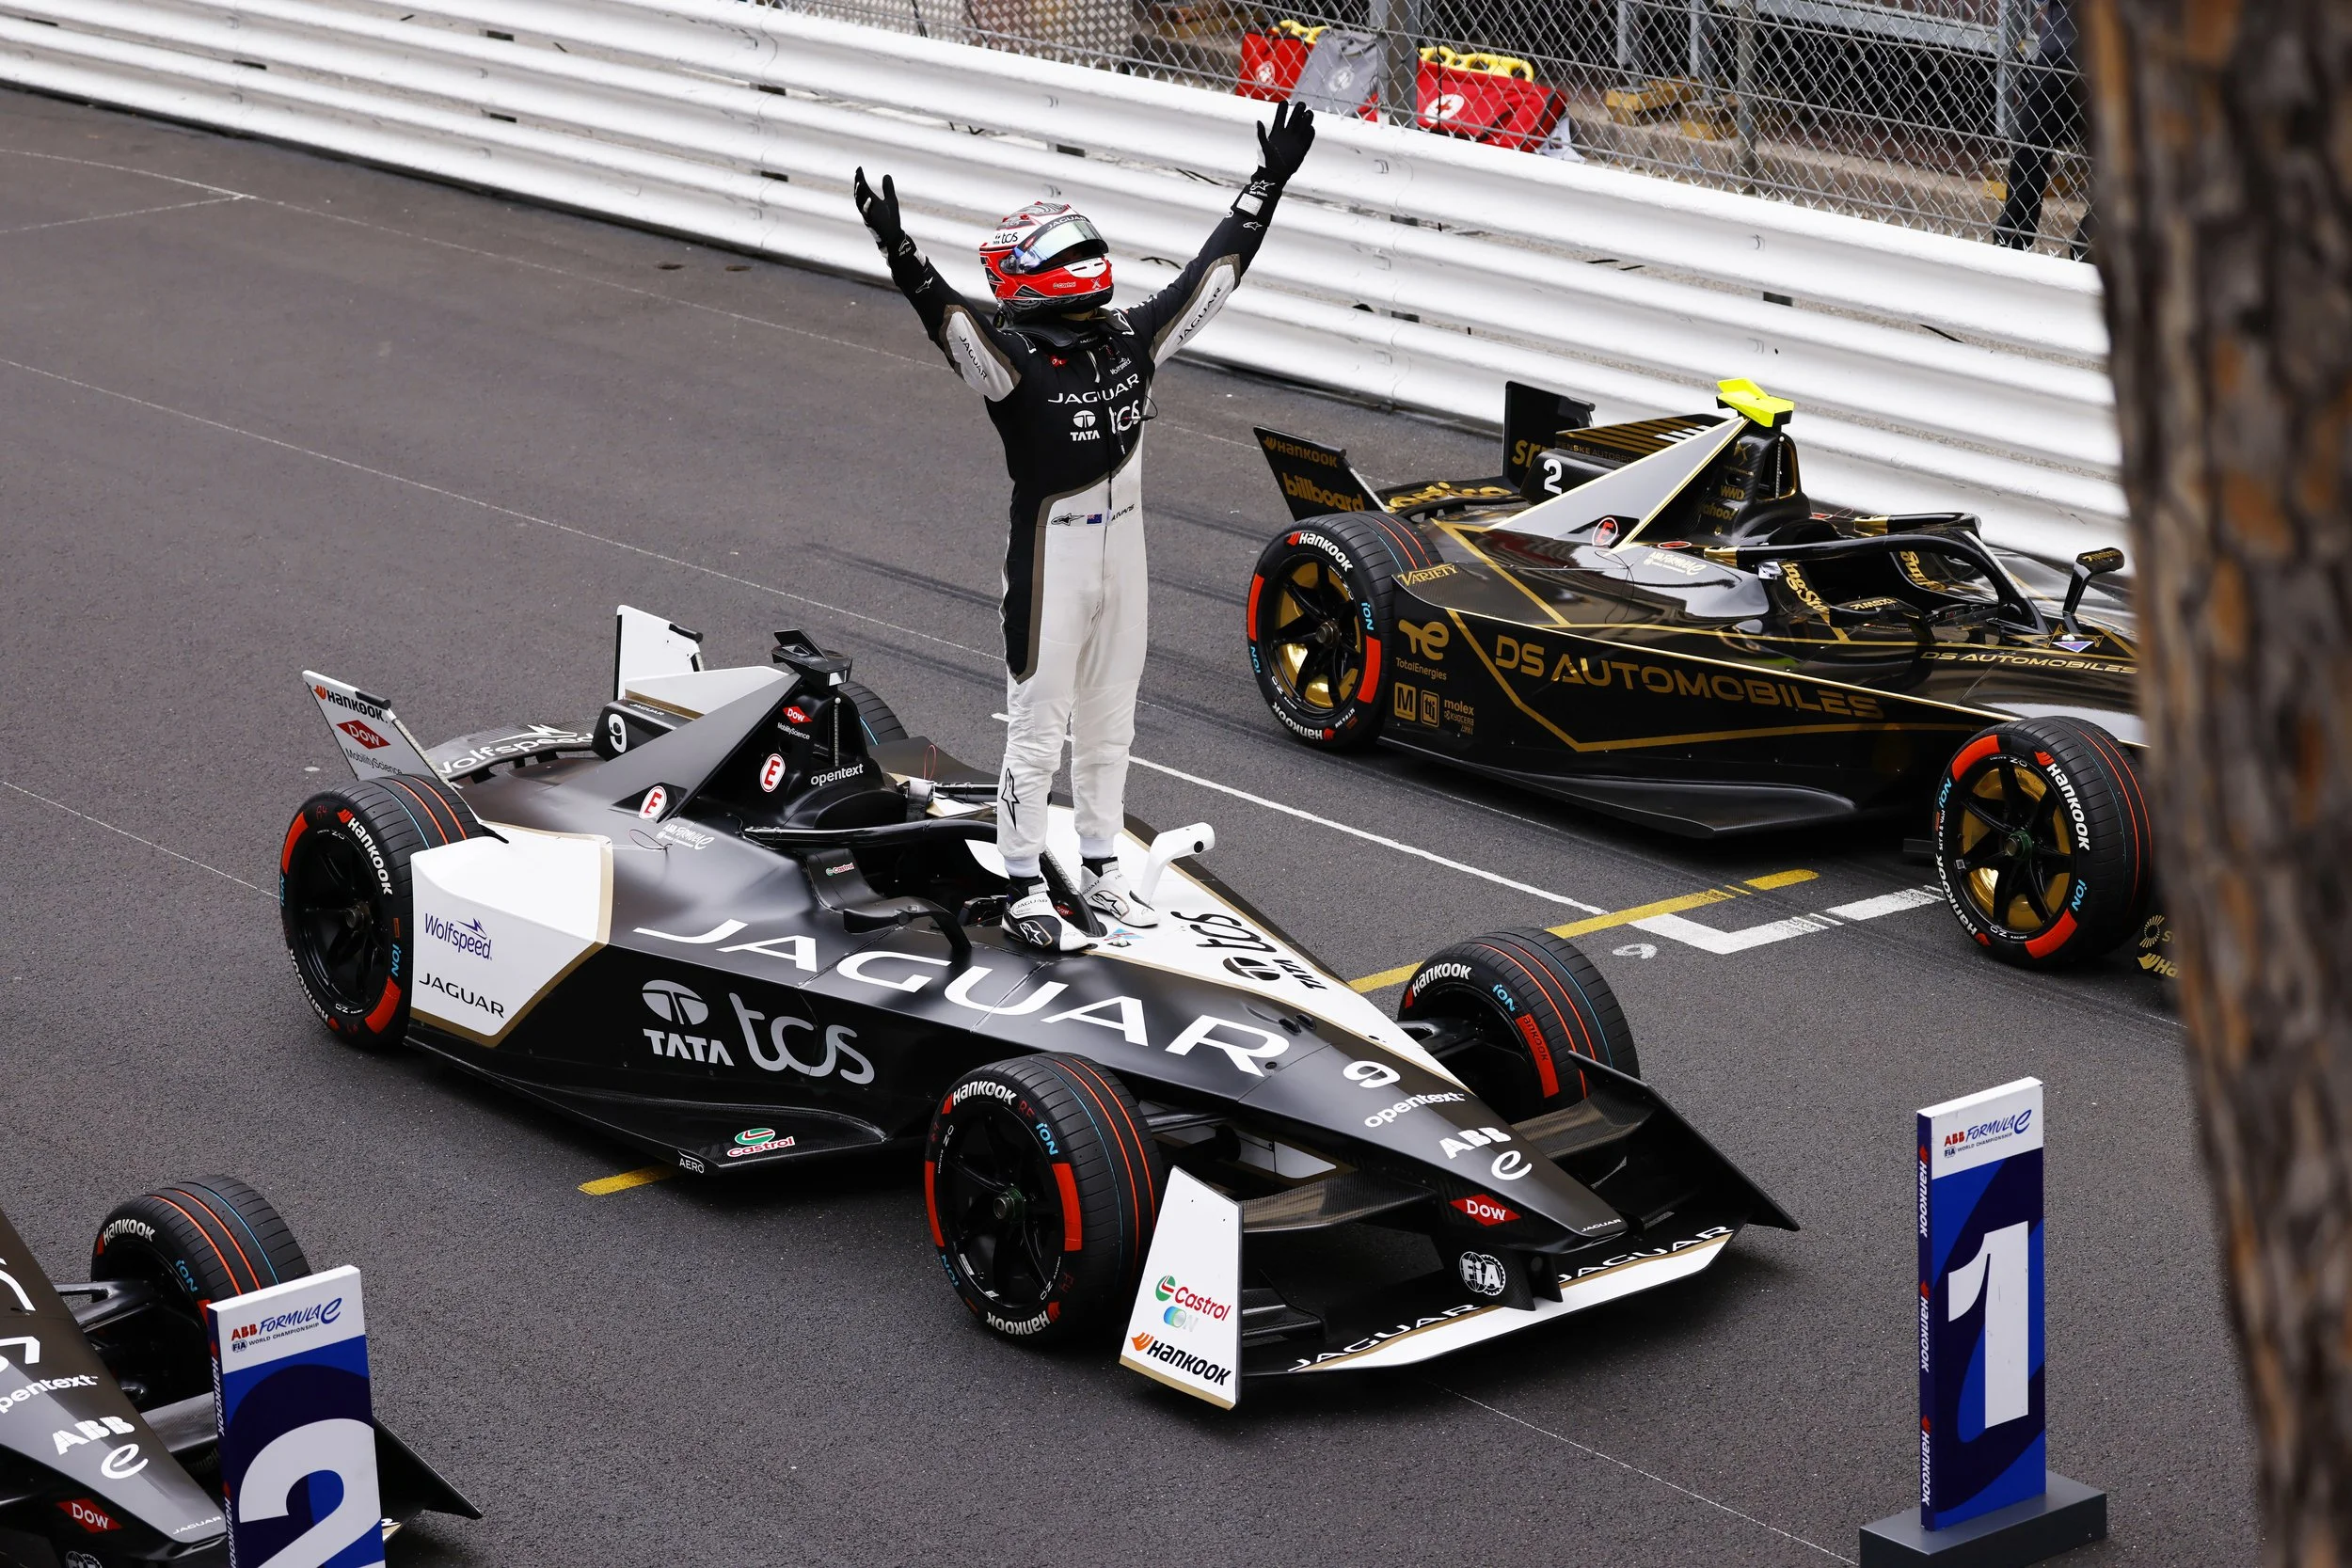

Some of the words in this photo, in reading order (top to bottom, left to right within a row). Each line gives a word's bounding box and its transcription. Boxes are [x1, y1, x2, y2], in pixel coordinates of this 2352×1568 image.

[1001, 232, 1018, 245] tcs
[1046, 215, 1087, 231] JAGUAR
[1177, 286, 1222, 345] JAGUAR
[959, 335, 988, 380] JAGUAR
[1047, 373, 1139, 405] JAGUAR
[1070, 430, 1101, 441] TATA
[1108, 400, 1139, 435] tcs
[1277, 441, 1338, 467] Hankook
[1282, 472, 1366, 513] billboard
[1543, 458, 1563, 495] 2
[1721, 485, 1745, 500] WWD
[1298, 531, 1353, 573] Hankook
[1397, 564, 1459, 587] VARIETY
[1395, 657, 1447, 682] TotalEnergies
[1496, 635, 1545, 677] DS
[1550, 657, 1884, 720] AUTOMOBILES
[1920, 651, 1959, 660] DS
[1959, 654, 2139, 674] AUTOMOBILES
[326, 689, 385, 721] Hankook
[629, 704, 665, 716] JAGUAR
[1273, 701, 1325, 741] Hankook
[1444, 699, 1474, 716] molex
[607, 713, 628, 753] 9
[777, 722, 811, 740] MobilityScience
[764, 760, 781, 787] E
[810, 763, 864, 787] opentext
[644, 793, 662, 815] E
[2046, 763, 2090, 851] Hankook
[348, 816, 393, 895] Hankook
[1016, 898, 1048, 909] JAGUAR
[1935, 852, 1978, 936] Hankook
[425, 912, 492, 961] Wolfspeed
[1169, 911, 1278, 953] tcs
[289, 947, 329, 1023] Hankook
[1272, 958, 1328, 990] TATA
[1411, 962, 1472, 998] Hankook
[419, 973, 505, 1019] JAGUAR
[632, 918, 1290, 1078] JAGUAR
[644, 1029, 735, 1066] TATA
[729, 992, 876, 1085] tcs
[1343, 1060, 1402, 1089] 9
[952, 1081, 1018, 1106] Hankook
[1364, 1090, 1464, 1129] opentext
[727, 1136, 795, 1158] Castrol
[1438, 1127, 1512, 1161] ABB
[1944, 1132, 1965, 1147] ABB
[1965, 1115, 2016, 1143] FORMULA
[1957, 1143, 1975, 1152] WORLD
[1976, 1132, 2013, 1147] CHAMPIONSHIP
[679, 1158, 705, 1174] AERO
[1919, 1160, 1929, 1237] Hankook
[103, 1218, 155, 1247] Hankook
[1581, 1218, 1623, 1233] JAGUAR
[1557, 1225, 1737, 1285] JAGUAR
[1174, 1286, 1232, 1322] Castrol
[231, 1323, 258, 1341] ABB
[258, 1306, 321, 1337] FORMULA
[231, 1341, 247, 1353] FIA
[248, 1335, 271, 1346] WORLD
[272, 1322, 320, 1339] CHAMPIONSHIP
[986, 1309, 1051, 1336] Hankook
[1287, 1304, 1481, 1372] JAGUAR
[1920, 1295, 1930, 1373] Hankook
[1947, 1221, 2028, 1430] 1
[1147, 1338, 1232, 1386] Hankook
[0, 1372, 97, 1414] pentext
[211, 1355, 225, 1437] Hankook
[52, 1415, 135, 1456] ABB
[1921, 1428, 1931, 1507] Hankook
[238, 1418, 383, 1568] 2
[172, 1515, 222, 1535] JAGUAR
[224, 1497, 237, 1568] Hankoo
